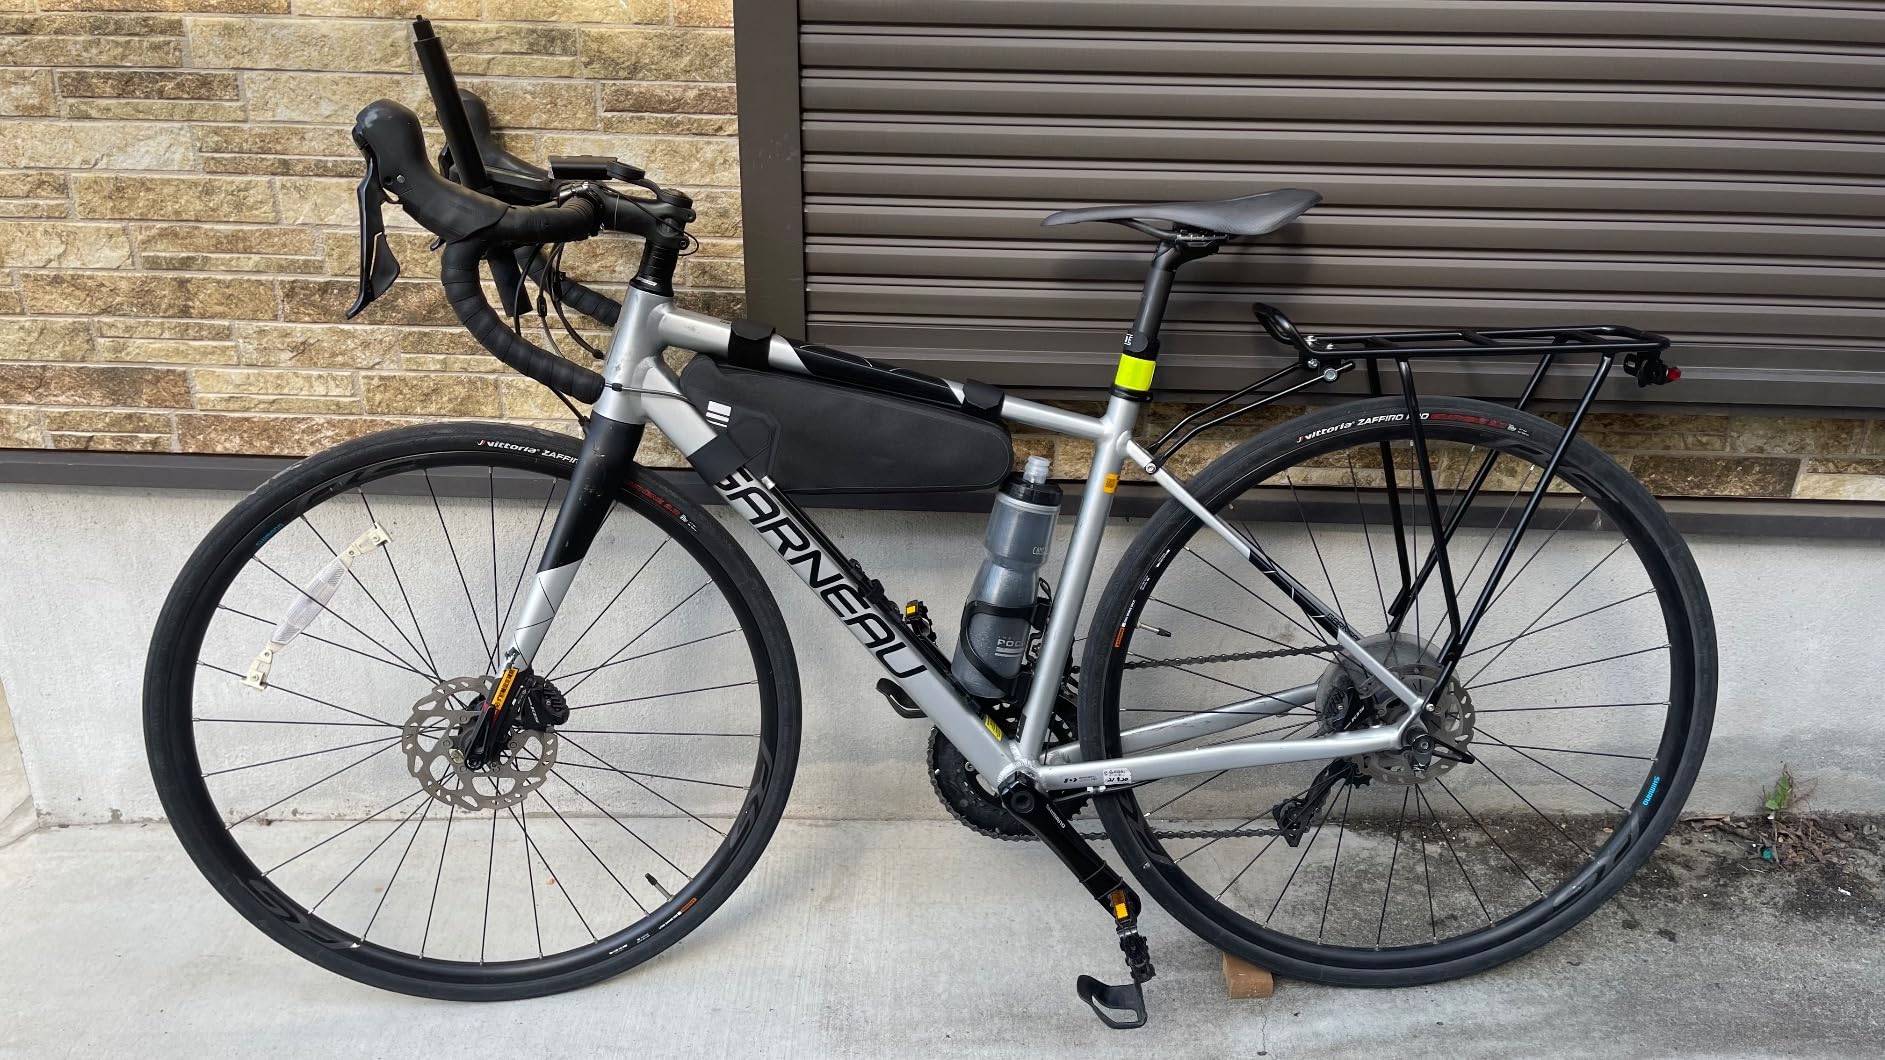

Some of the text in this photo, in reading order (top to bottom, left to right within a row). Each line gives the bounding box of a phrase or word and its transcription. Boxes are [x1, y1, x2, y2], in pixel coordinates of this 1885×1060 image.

[1304, 420, 1352, 441] vittoria
[1357, 412, 1404, 426] ZAFFIRO
[486, 439, 538, 454] vittoria
[1642, 776, 1660, 805] SHIMANO
